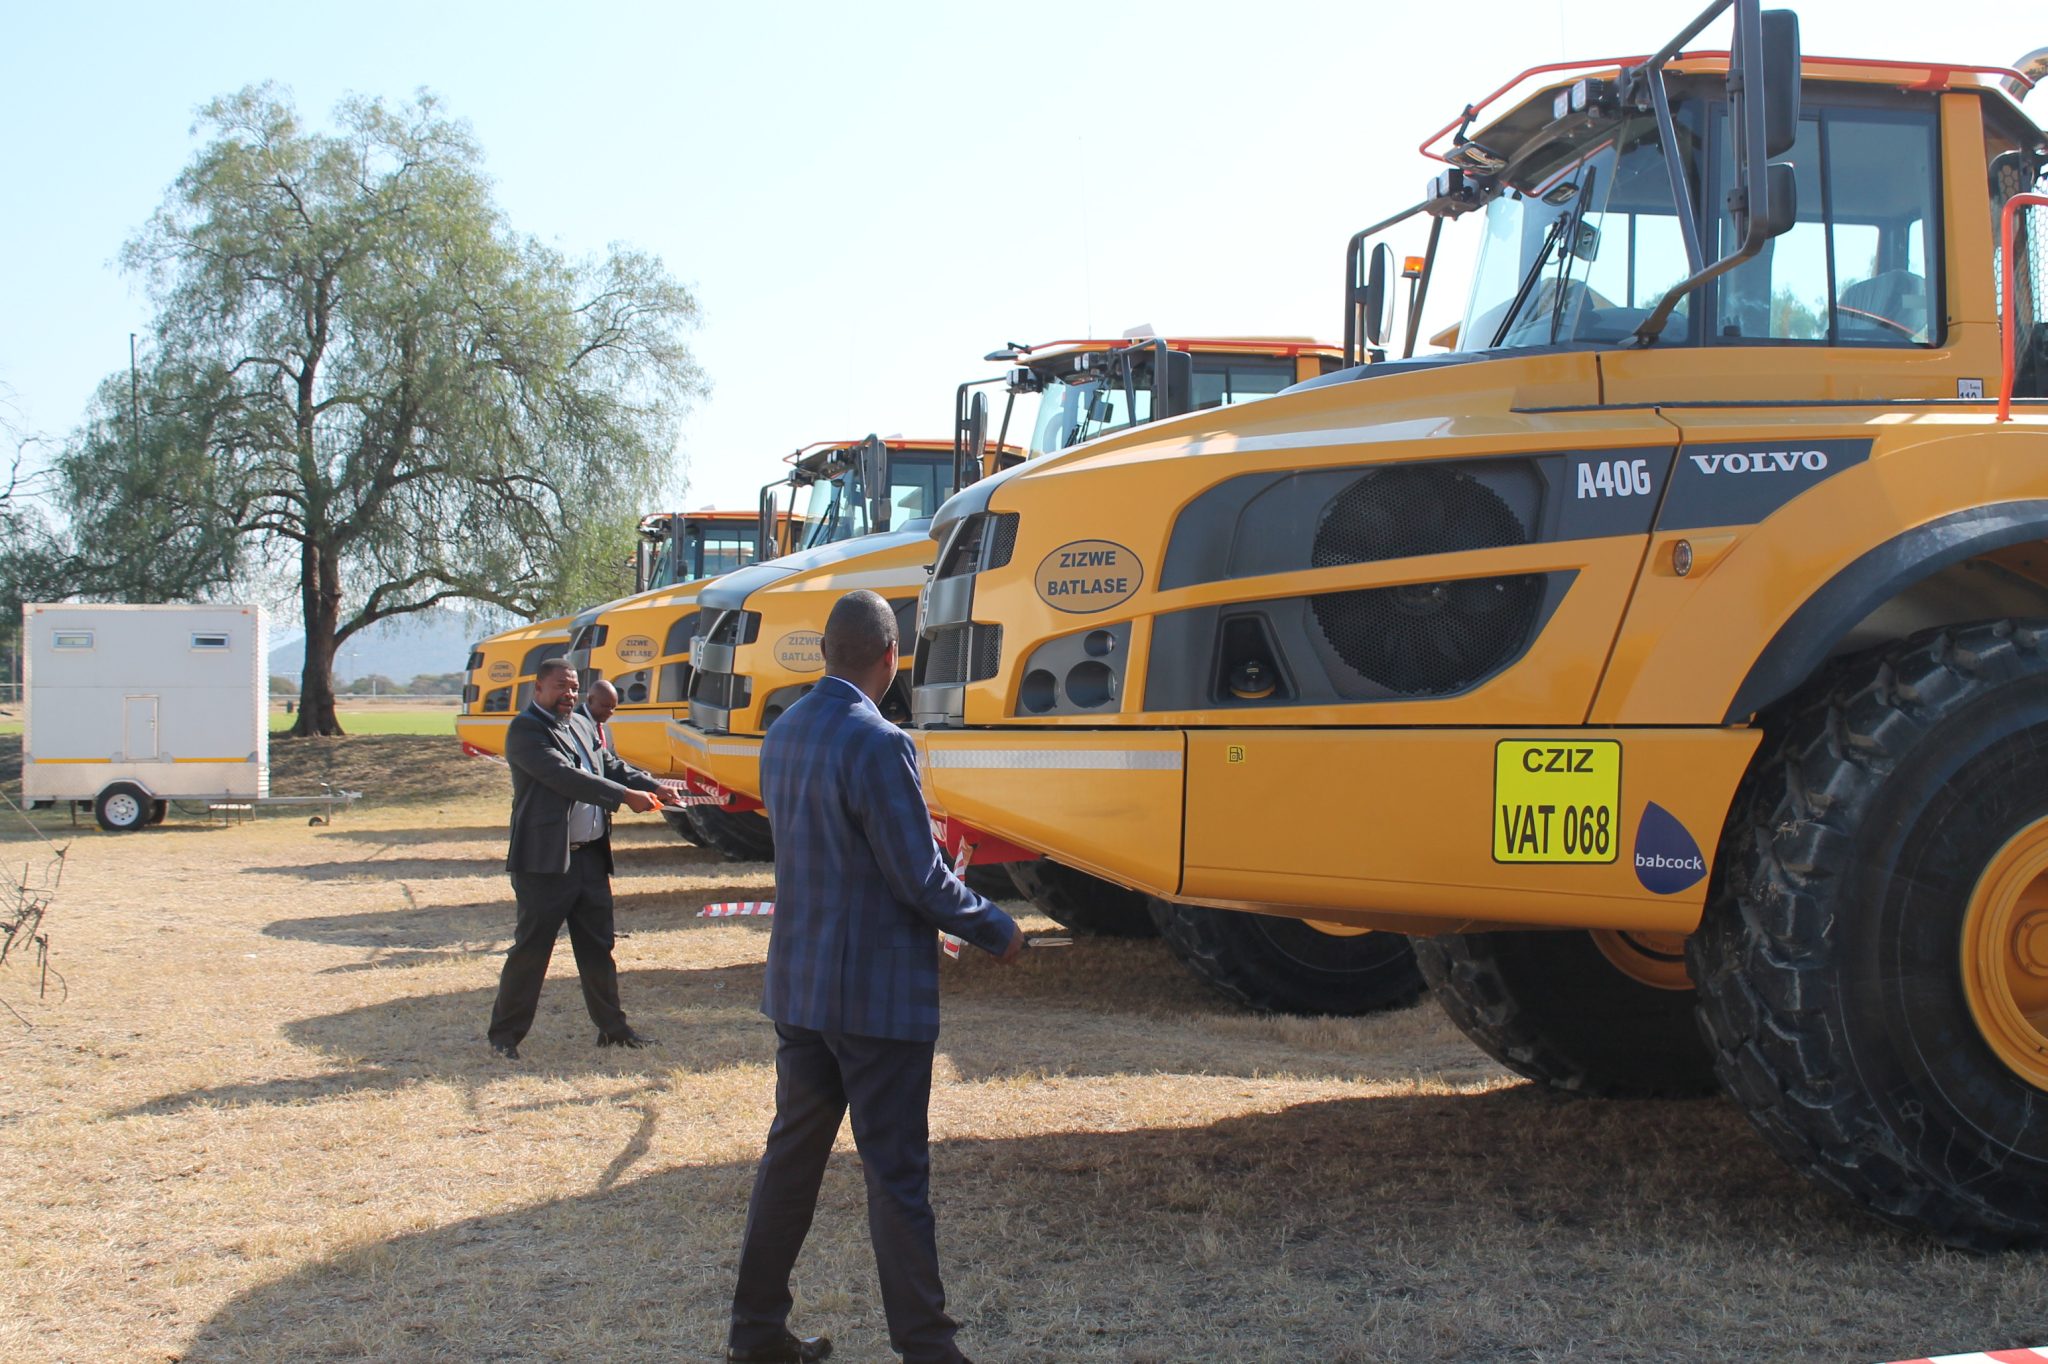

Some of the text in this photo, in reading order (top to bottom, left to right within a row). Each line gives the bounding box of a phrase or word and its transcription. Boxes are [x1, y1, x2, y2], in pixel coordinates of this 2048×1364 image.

[1690, 450, 1828, 475] VOLVO
[1577, 459, 1651, 499] A40G
[1059, 550, 1116, 568] ZIZWE
[1047, 577, 1128, 596] BATLASE
[788, 636, 821, 646] ZIZWE
[781, 652, 825, 662] BATLAS
[1522, 748, 1594, 773] CZIZ
[1502, 804, 1610, 855] VAT 068
[1635, 853, 1702, 871] babcock
